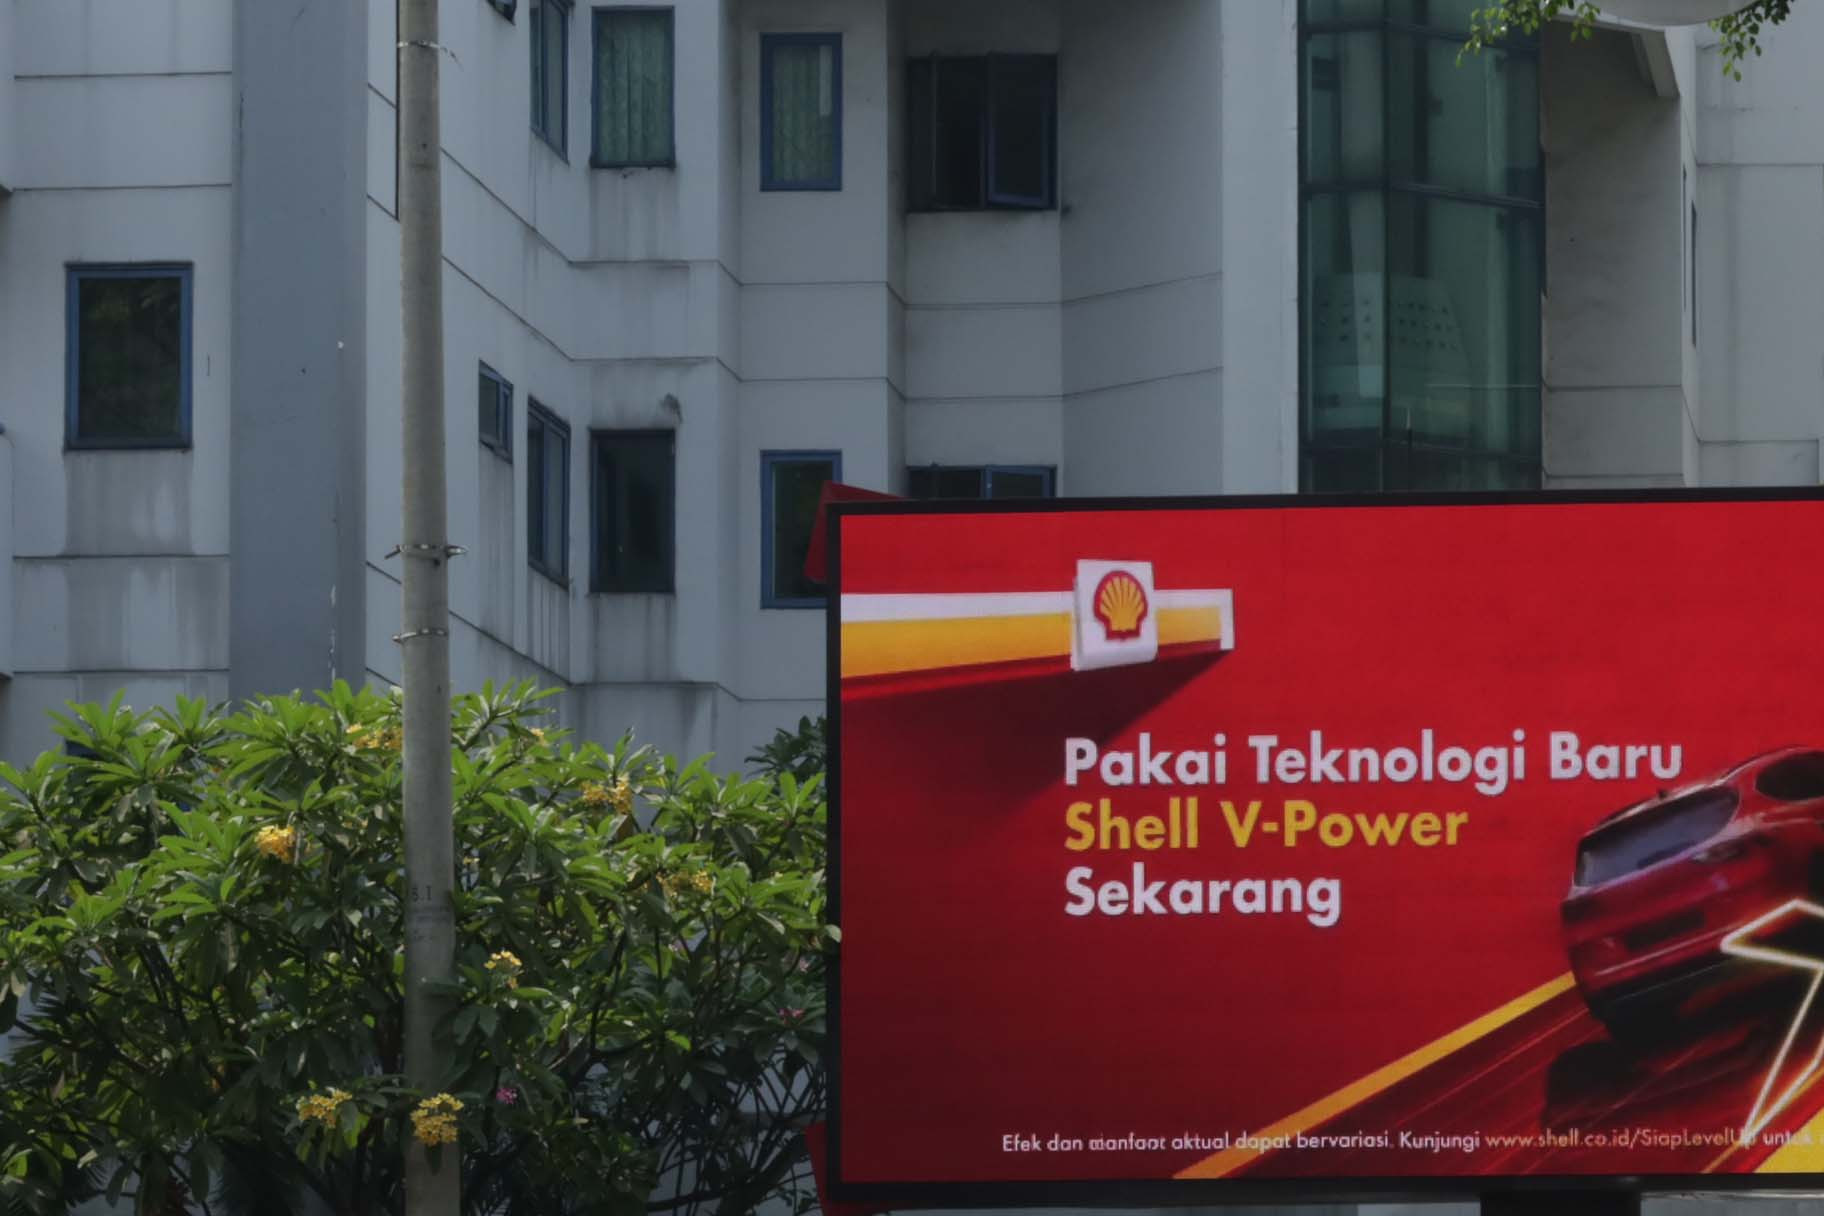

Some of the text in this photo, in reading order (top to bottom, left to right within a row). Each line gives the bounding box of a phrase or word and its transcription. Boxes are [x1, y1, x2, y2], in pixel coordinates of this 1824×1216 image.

[1064, 729, 1683, 796] Pakai Teknologi Baru
[1064, 796, 1469, 852] Shell V-Power
[1064, 861, 1341, 927] Sekarang
[1002, 1133, 1041, 1152] Efek
[1047, 1133, 1082, 1151] dan
[1171, 1131, 1230, 1150] aktual
[1235, 1130, 1290, 1154] dapat
[1297, 1128, 1395, 1149] bervariasi.
[1400, 1129, 1480, 1154] Kunjungi
